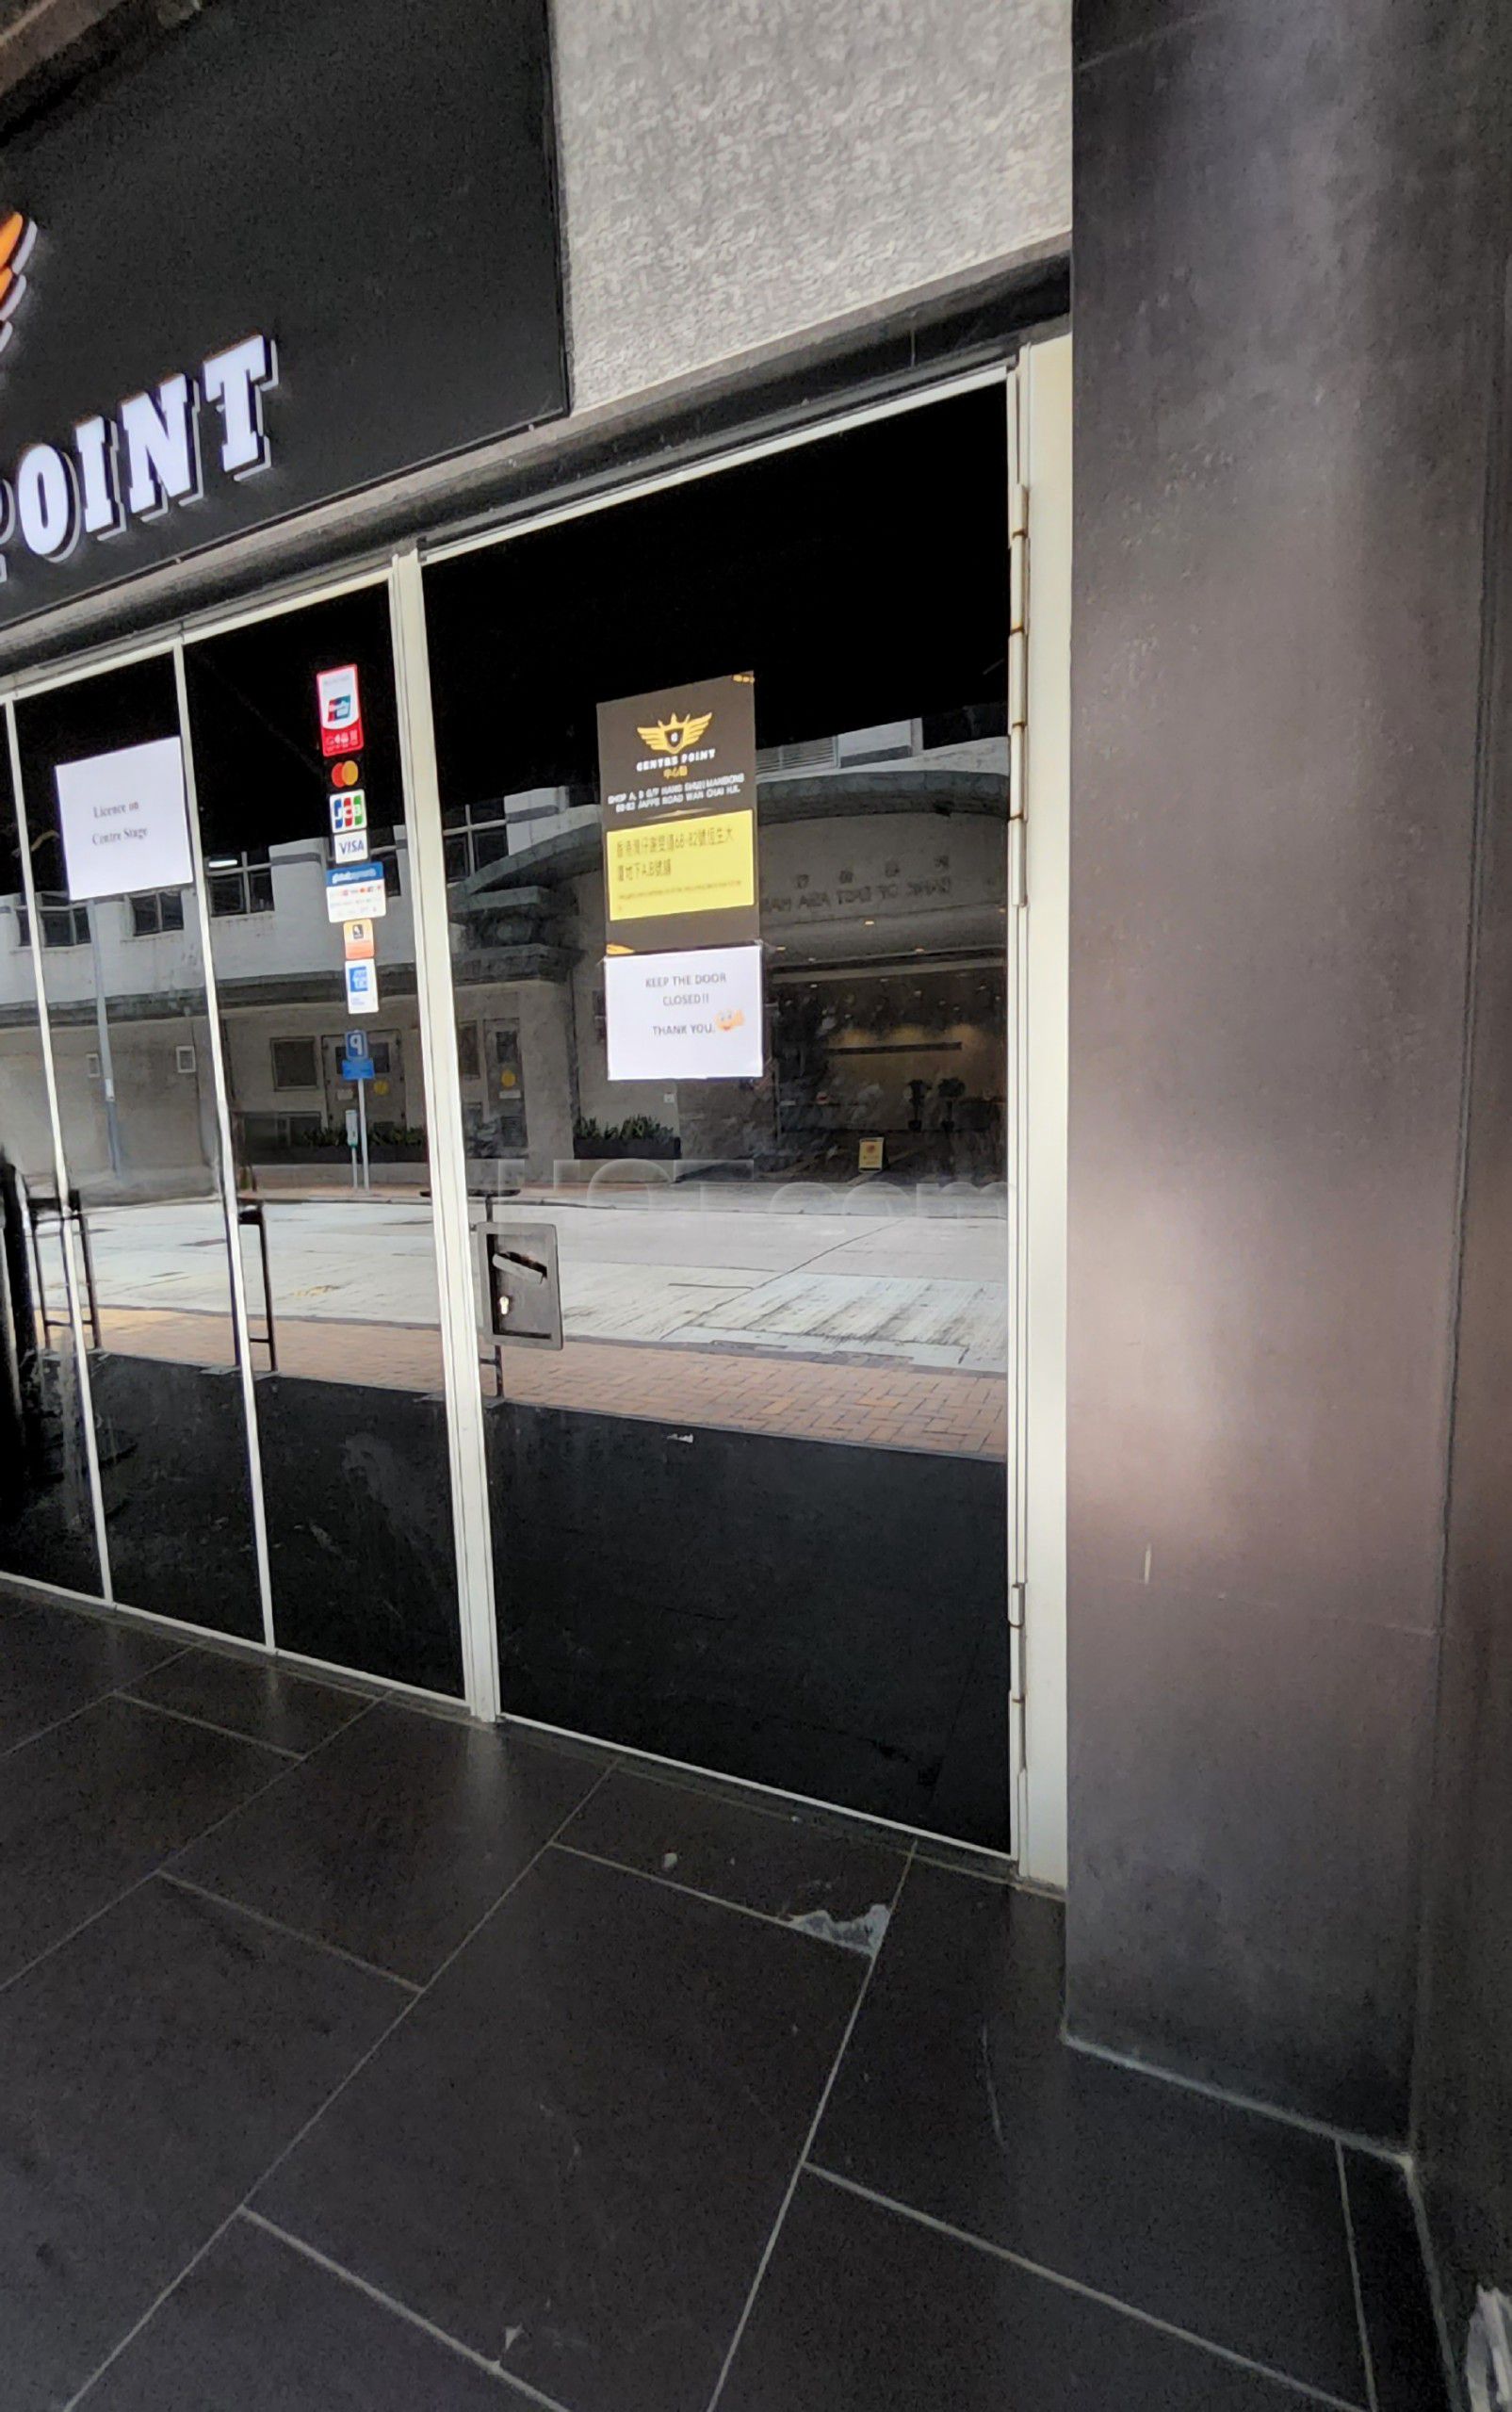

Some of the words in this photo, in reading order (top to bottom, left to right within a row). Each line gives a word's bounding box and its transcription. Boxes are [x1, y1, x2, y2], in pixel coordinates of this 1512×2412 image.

[0, 334, 280, 582] OINT
[681, 749, 715, 763] POINT
[661, 793, 684, 805] ROAD
[333, 795, 365, 829] JCB
[339, 839, 366, 856] VISA
[645, 977, 669, 988] KEEP
[673, 974, 691, 986] THE
[695, 972, 726, 986] DOOR
[652, 1025, 688, 1036] THANK
